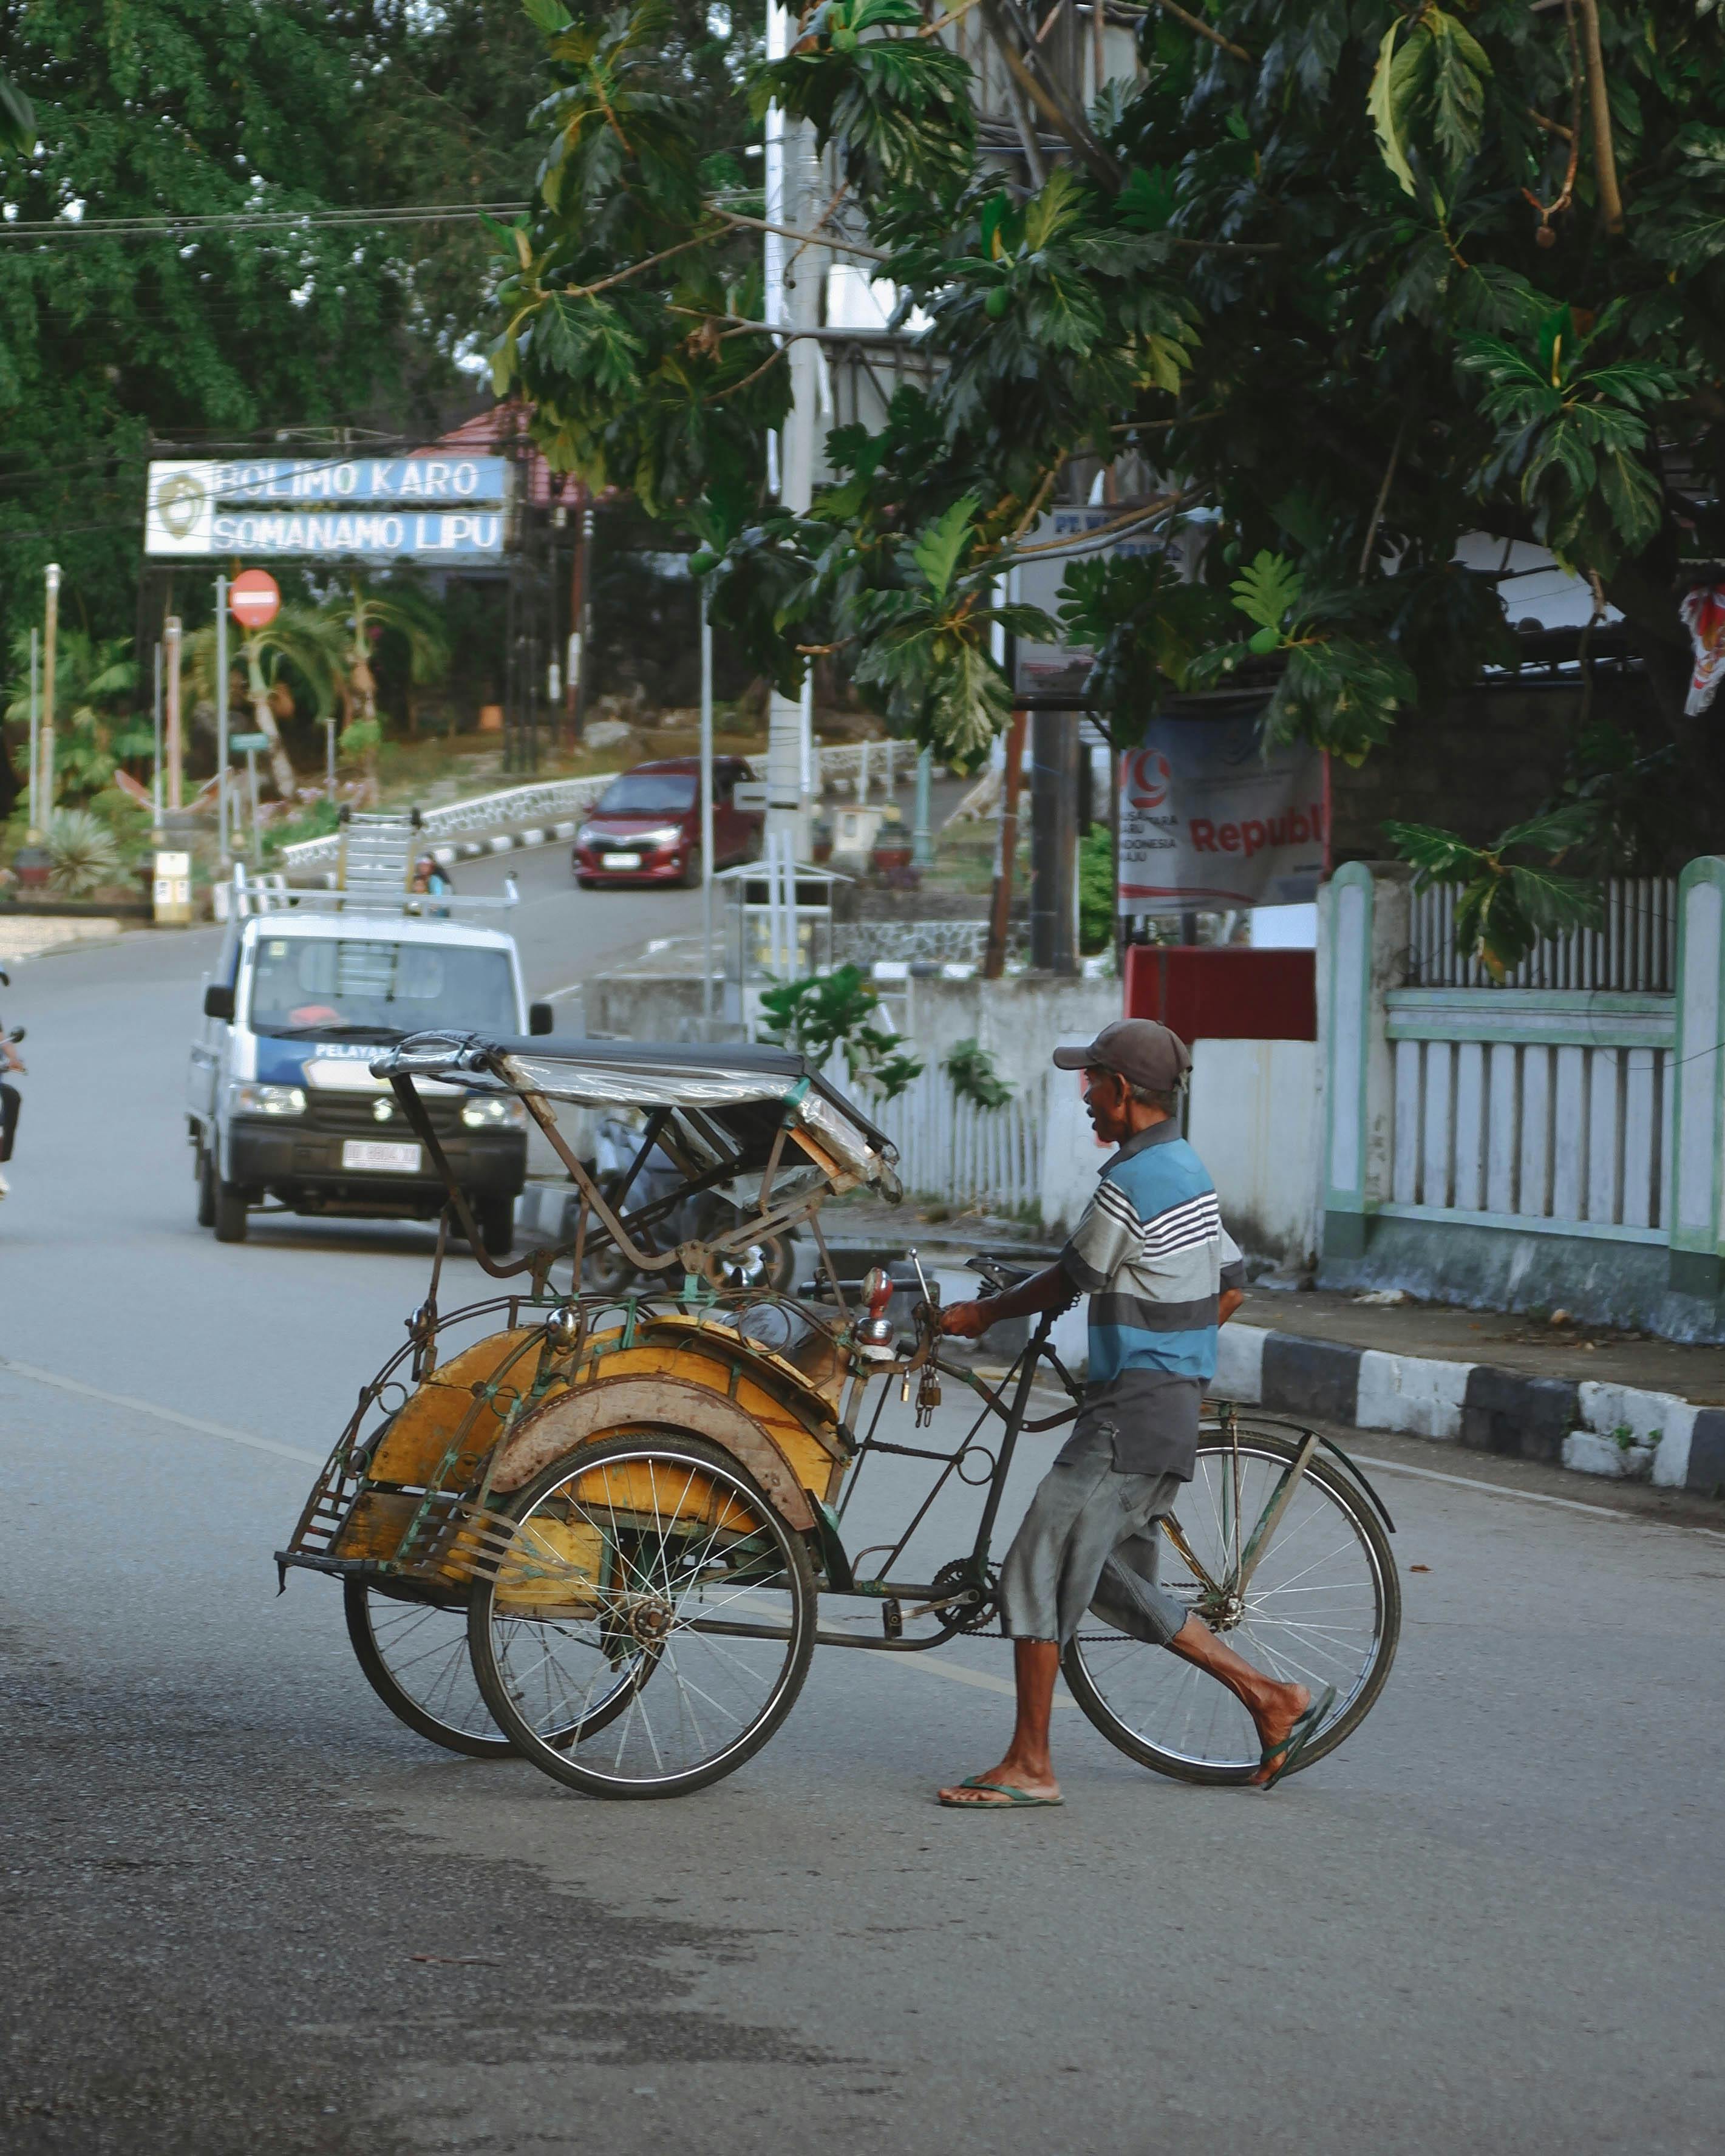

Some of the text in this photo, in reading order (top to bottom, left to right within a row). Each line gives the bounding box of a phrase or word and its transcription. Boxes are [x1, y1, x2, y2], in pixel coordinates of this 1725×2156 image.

[215, 462, 478, 496] BOLIMO KARO
[214, 515, 498, 549] SOMANAMO LIPU
[1189, 803, 1324, 858] Republ
